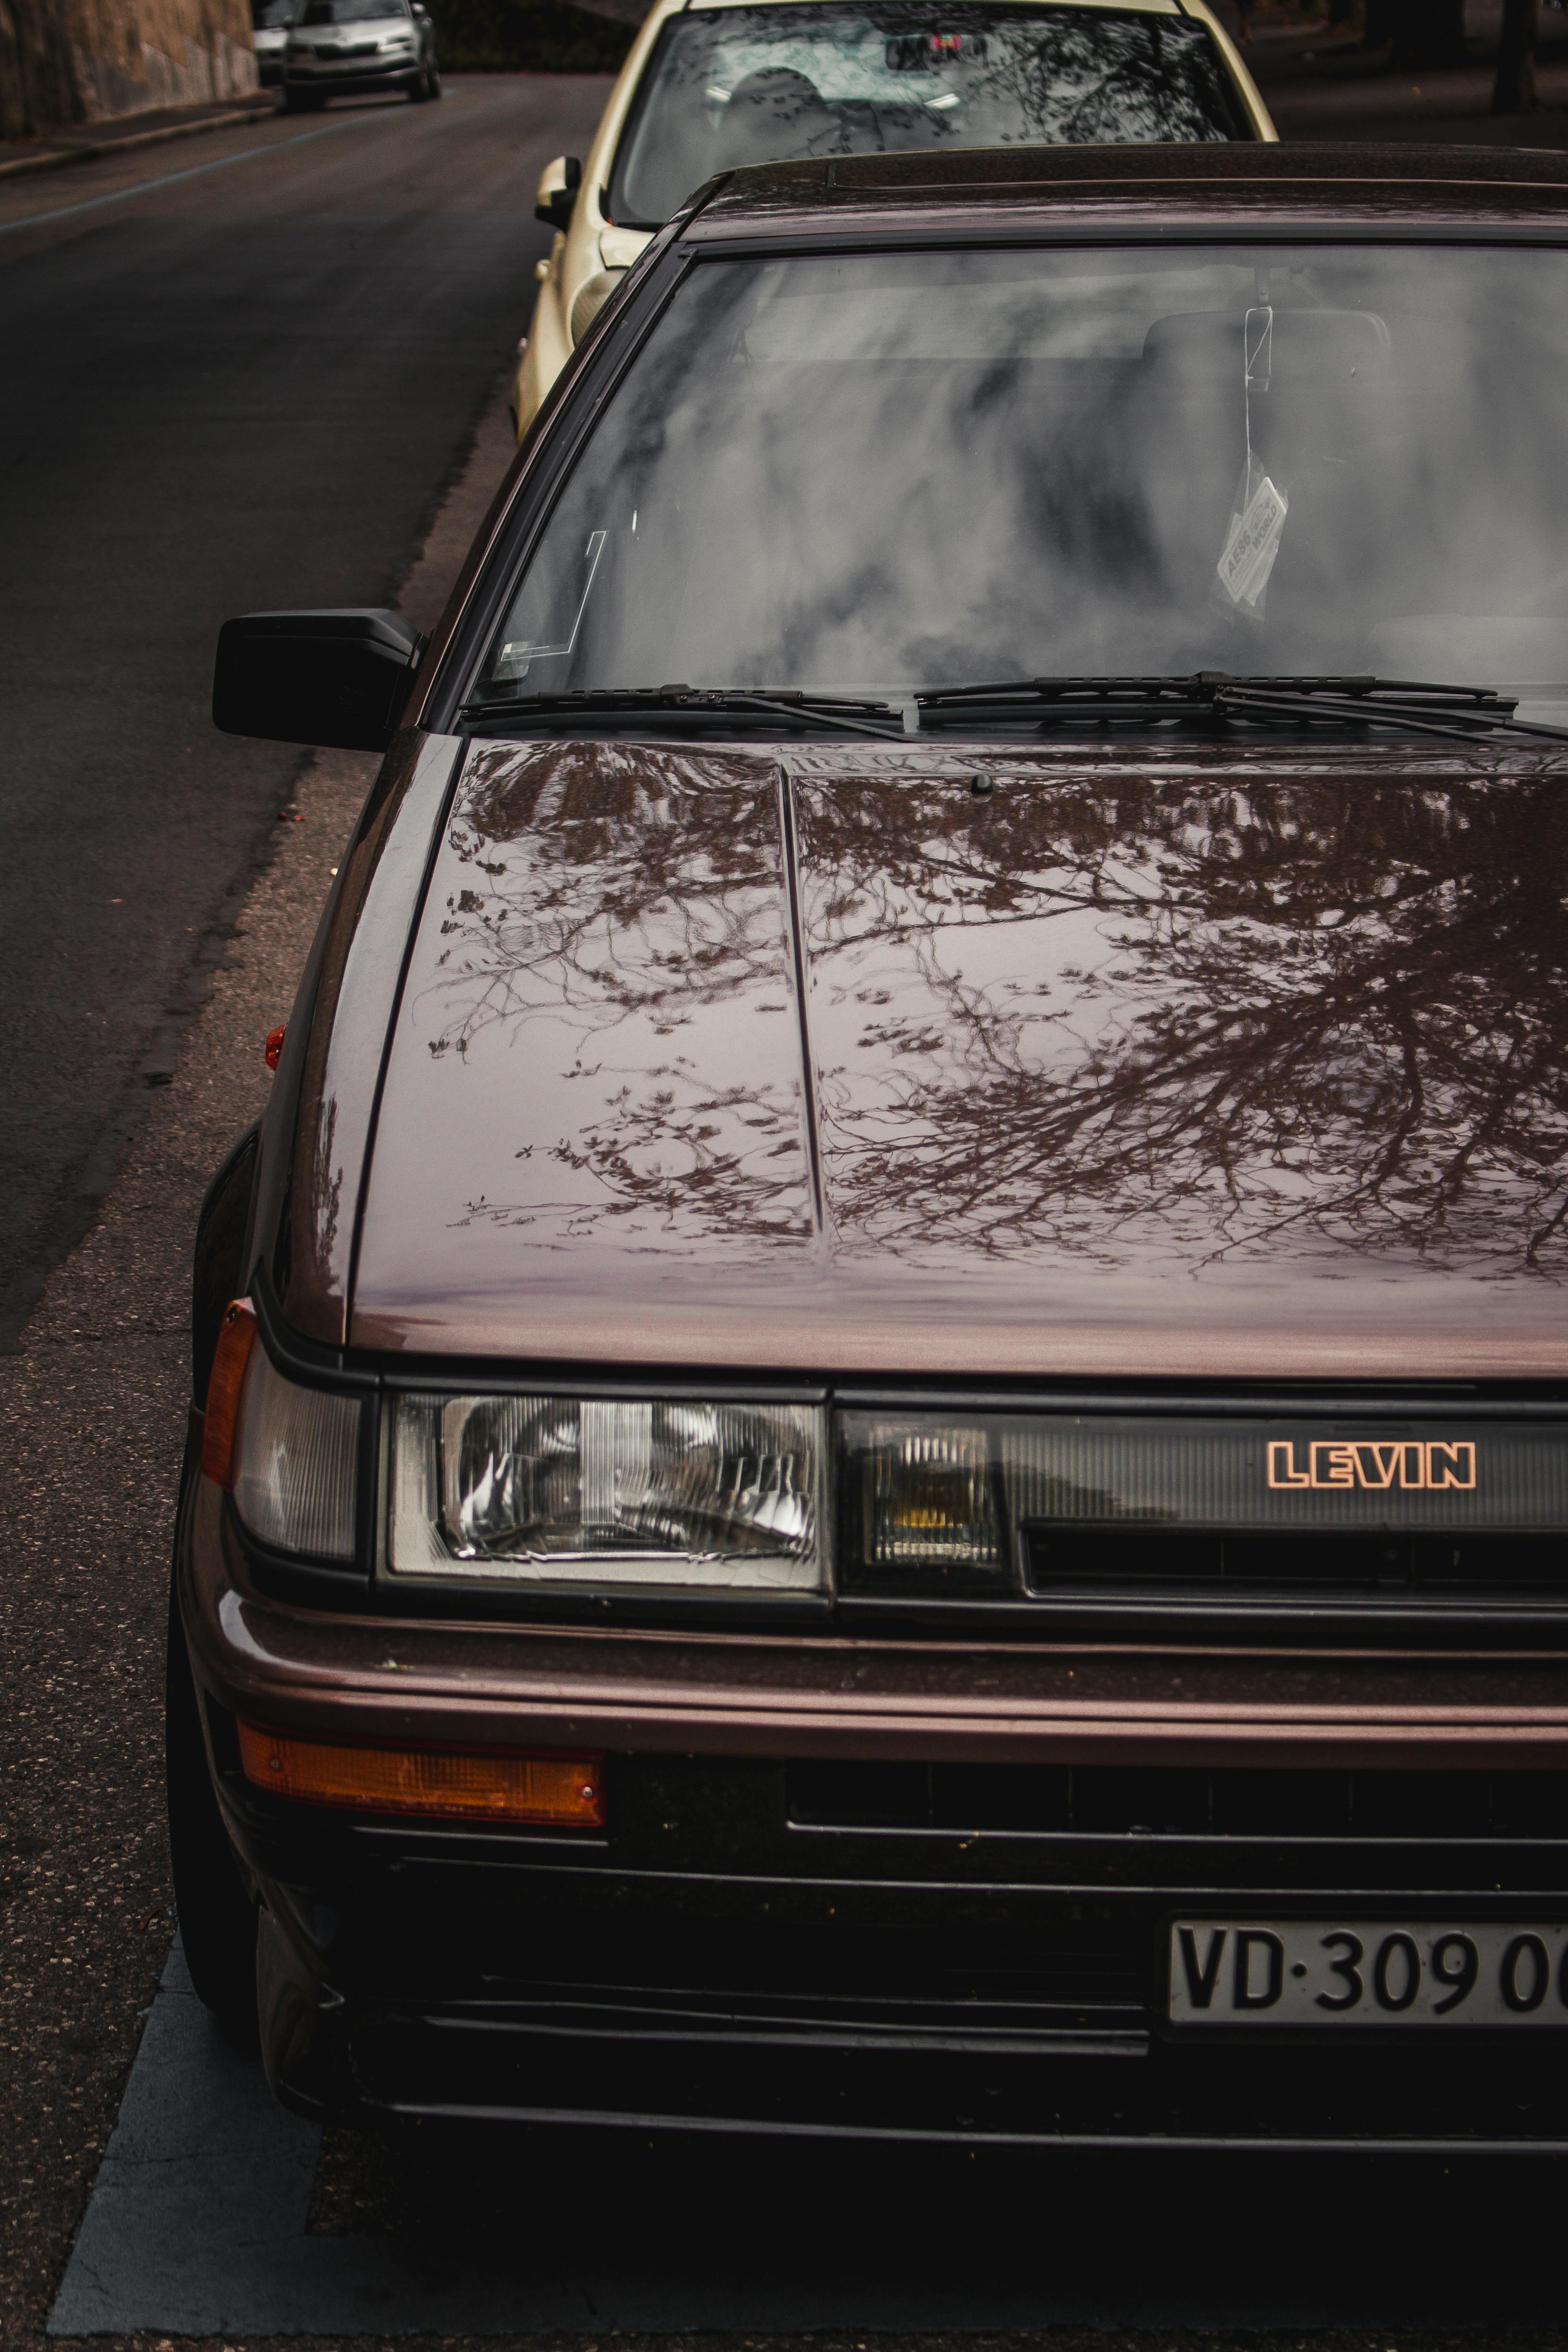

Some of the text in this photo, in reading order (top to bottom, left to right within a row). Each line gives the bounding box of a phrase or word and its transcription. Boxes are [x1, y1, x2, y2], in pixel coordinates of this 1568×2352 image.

[1253, 505, 1277, 550] WORLD
[1228, 530, 1250, 577] AE86
[1266, 1441, 1477, 1488] LEVIN
[1499, 1931, 1568, 2013] 0
